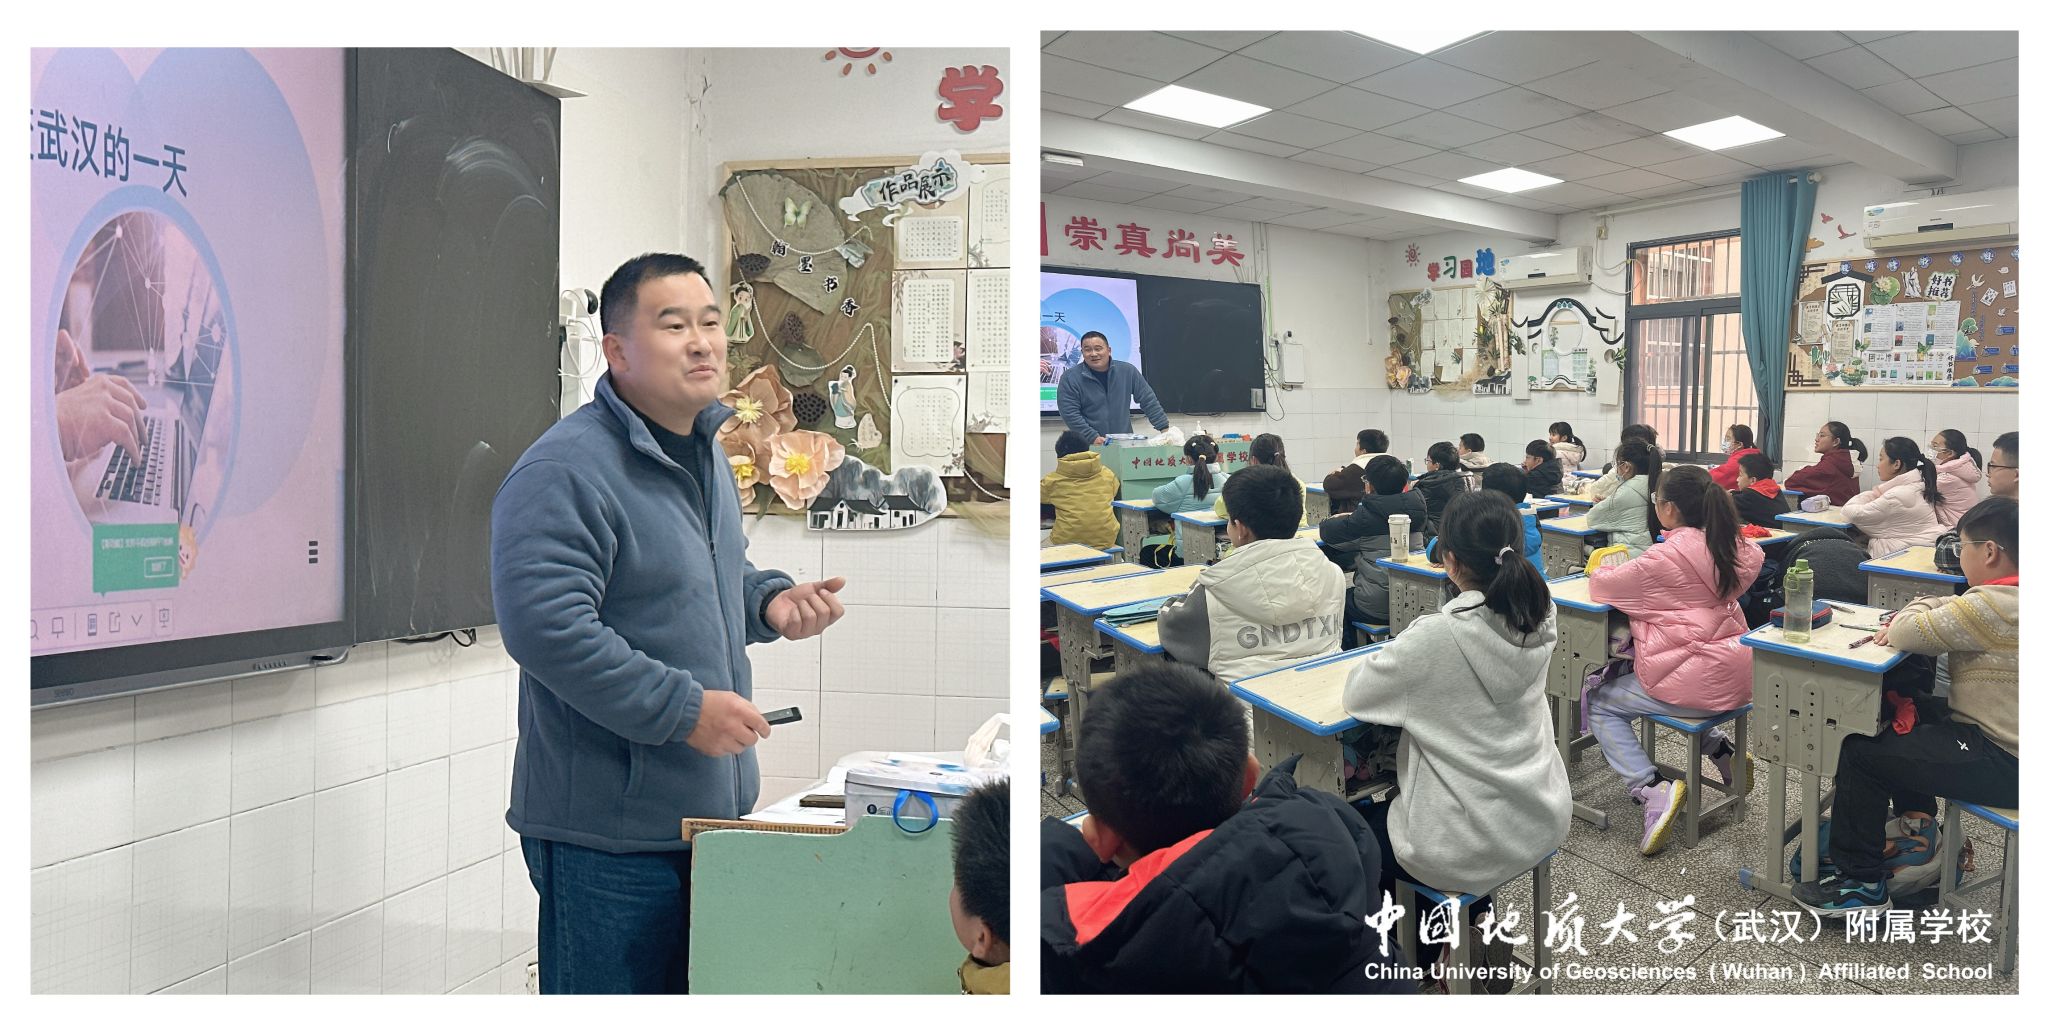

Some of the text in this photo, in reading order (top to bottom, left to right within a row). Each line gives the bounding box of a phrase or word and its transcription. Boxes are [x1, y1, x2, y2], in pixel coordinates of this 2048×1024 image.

[938, 65, 1003, 131] 学
[30, 109, 187, 197] 武汉的一天
[879, 168, 951, 201] 作品展示
[1064, 215, 1246, 267] 崇真尚美
[1427, 247, 1496, 282] 学习园地
[772, 239, 861, 316] 翰墨书香
[1042, 311, 1066, 322] 一天
